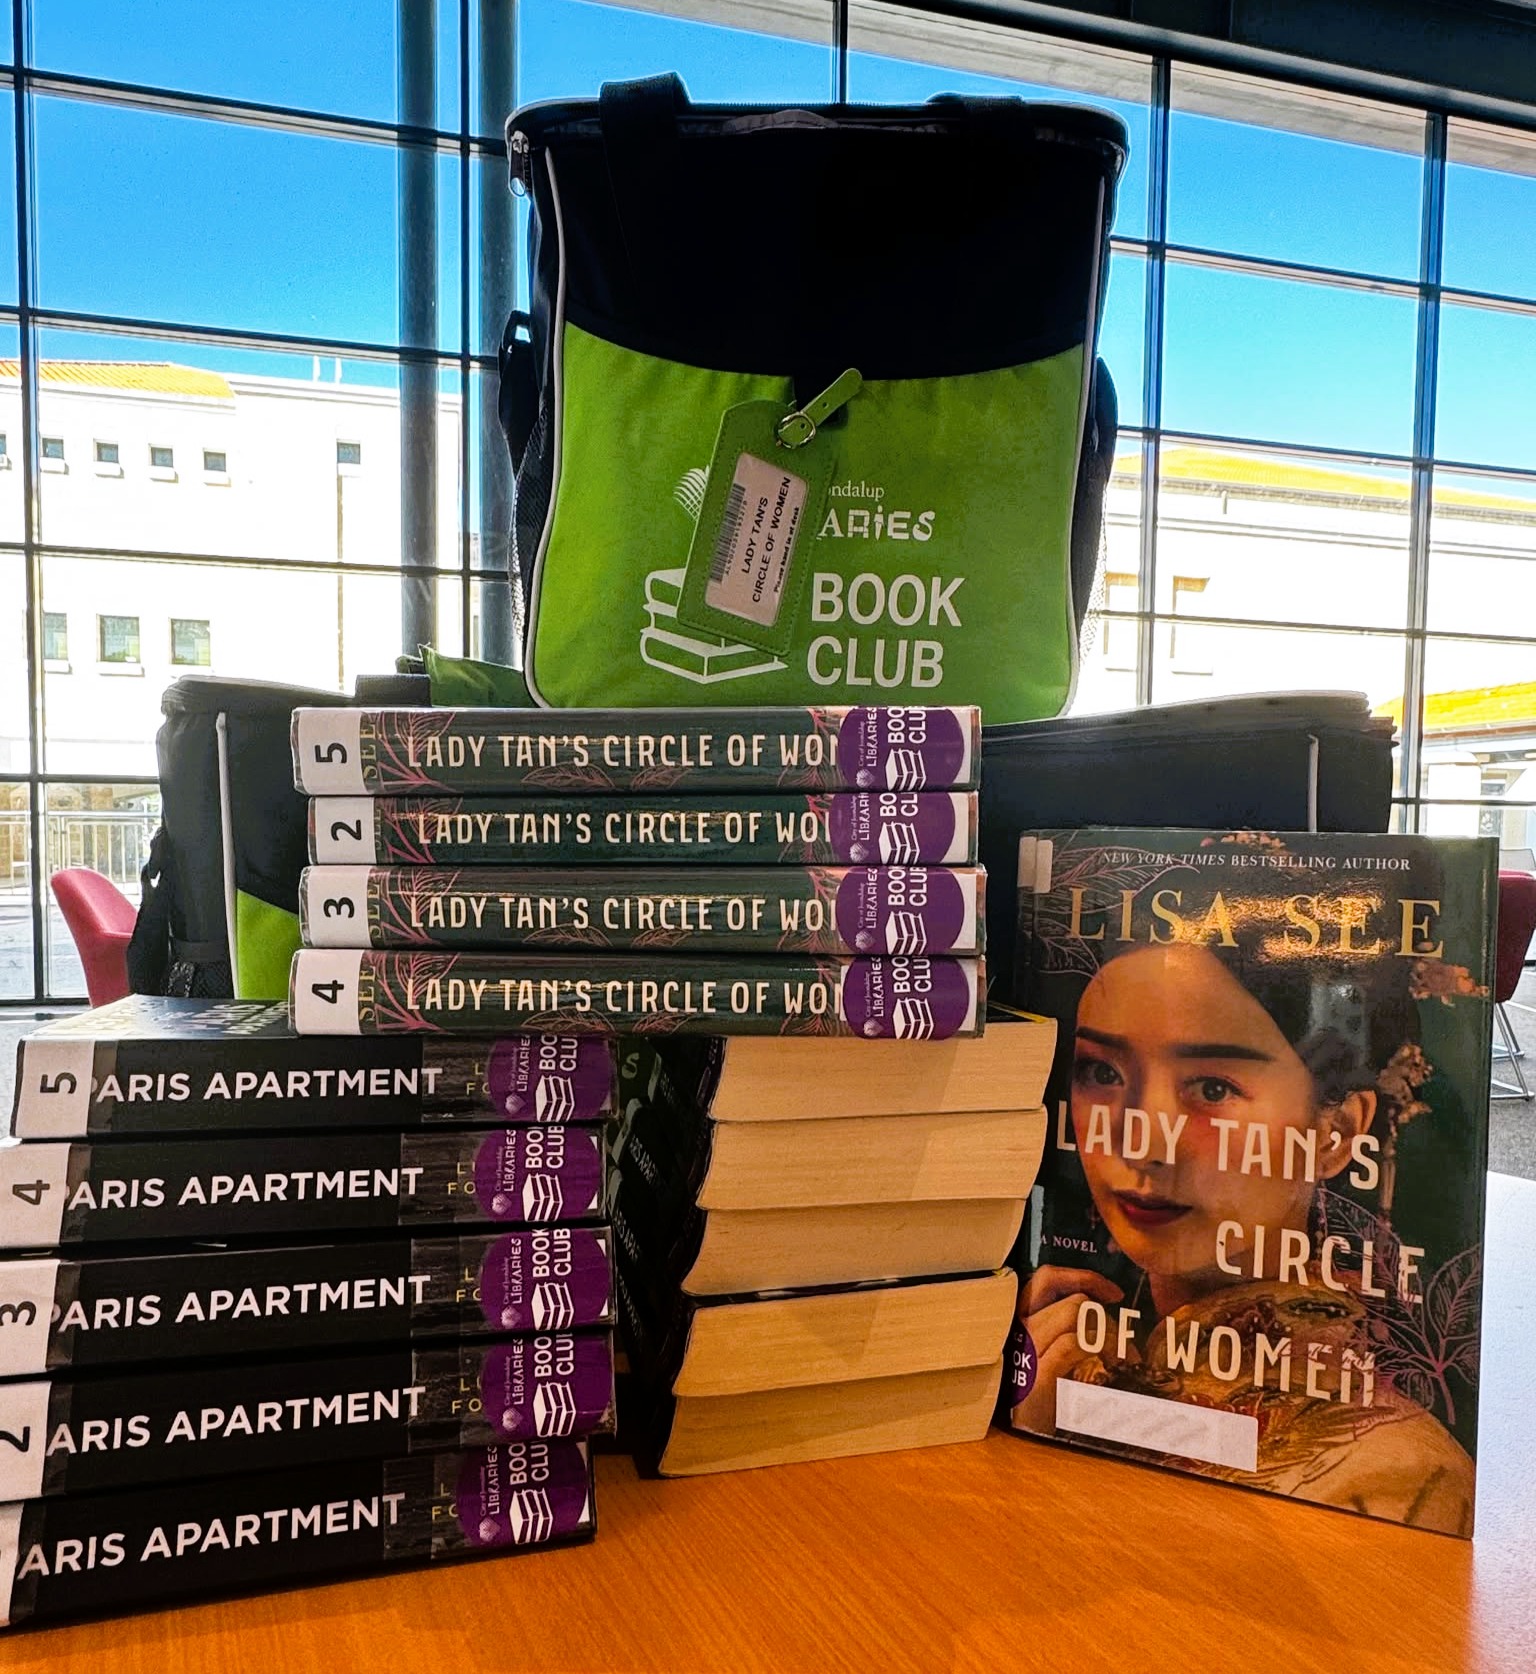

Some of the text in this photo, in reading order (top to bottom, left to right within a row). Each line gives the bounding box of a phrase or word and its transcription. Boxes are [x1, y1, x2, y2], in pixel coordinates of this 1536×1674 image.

[828, 480, 885, 501] ndalup
[741, 497, 768, 574] LADY TAN'S
[752, 477, 791, 603] CIRCLE OF WOMEN
[816, 504, 936, 541] ARIES
[811, 572, 966, 627] BOOK
[806, 635, 944, 688] CLUB
[315, 742, 348, 764] 5
[408, 735, 486, 767] LADY
[498, 734, 590, 767] TAN'S
[602, 735, 713, 767] CIRCLE
[727, 734, 766, 767] OF
[901, 792, 919, 817] CL
[331, 819, 361, 841] 2
[418, 813, 492, 844] LADY
[505, 813, 592, 844] TAN'S
[604, 812, 711, 844] CIRCLE
[725, 812, 762, 844] OF
[1100, 852, 1411, 871] NEW YORK TIMES BESTSELLING AUTHOR
[888, 866, 906, 906] BOO
[323, 896, 355, 919] 3
[410, 897, 487, 929] LADY
[500, 897, 590, 929] TAN'S
[602, 897, 713, 931] CIRCLE
[726, 898, 766, 931] OF
[1068, 887, 1445, 959] LISA SEE
[311, 979, 345, 1004] 4
[406, 978, 488, 1011] LADY
[500, 978, 592, 1012] TAN'S
[606, 980, 716, 1014] CIRCLE
[730, 980, 770, 1015] OF
[39, 1072, 77, 1095] 5
[91, 1067, 442, 1103] ARIS APARTMENT
[1057, 1100, 1380, 1190] LADY TAN'S
[12, 1179, 50, 1206] 4
[65, 1167, 423, 1211] ARIS APARTMENT
[532, 1228, 550, 1278] BOOK
[553, 1228, 572, 1276] CLUB
[1053, 1235, 1097, 1253] NOVEL
[1215, 1220, 1425, 1304] CIRCLE
[510, 1238, 523, 1304] LIBRARIES
[0, 1300, 37, 1326] 3
[175, 1275, 431, 1323] APARTMENT
[1076, 1300, 1375, 1408] OF WOMEN
[165, 1386, 426, 1443] APARTMENT
[140, 1493, 405, 1562] APARTMENT
